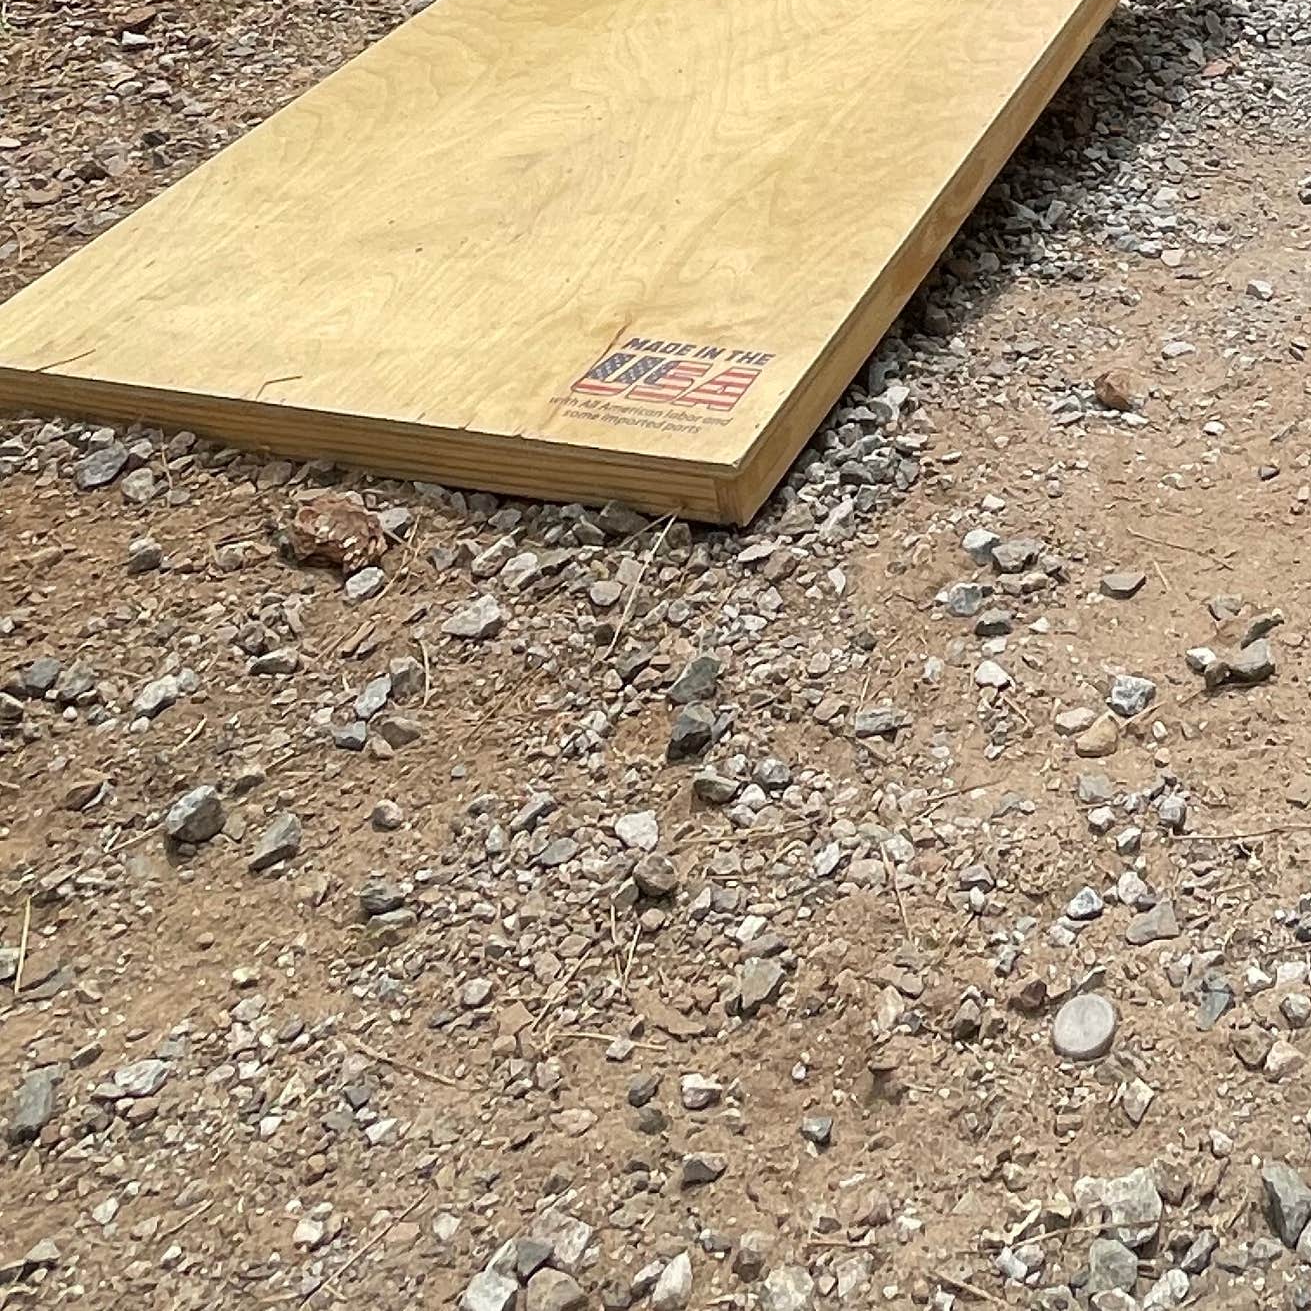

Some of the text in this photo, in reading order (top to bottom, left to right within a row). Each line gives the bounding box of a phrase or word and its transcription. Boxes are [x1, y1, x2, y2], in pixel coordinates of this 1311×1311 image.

[621, 338, 776, 366] MADE IN THE
[570, 353, 762, 412] USA
[562, 410, 702, 434] some imported parts
[600, 402, 661, 418] American
[663, 409, 702, 422] labor
[702, 416, 733, 426] and
